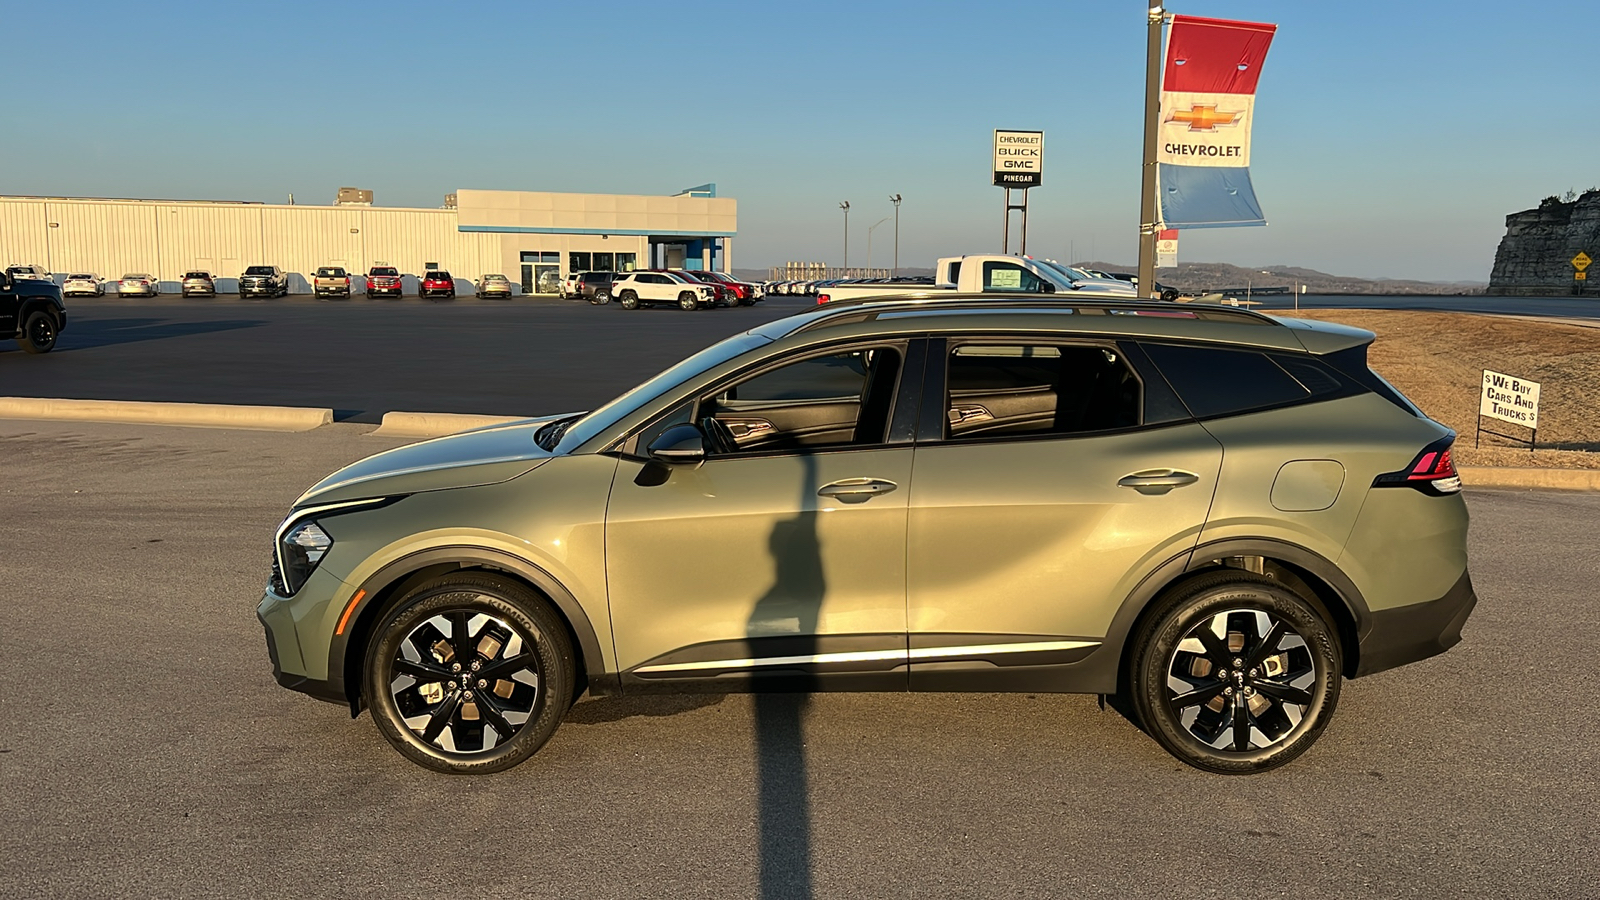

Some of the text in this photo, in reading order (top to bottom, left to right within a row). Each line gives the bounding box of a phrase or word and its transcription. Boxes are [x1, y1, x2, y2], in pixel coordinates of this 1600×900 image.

[1000, 136, 1039, 144] CHEVROLET
[998, 148, 1039, 156] BUICK
[1165, 143, 1241, 157] CHEVROLET
[1004, 160, 1033, 168] GMC
[488, 600, 532, 629] KUMHO
[1318, 671, 1334, 719] KUMHO
